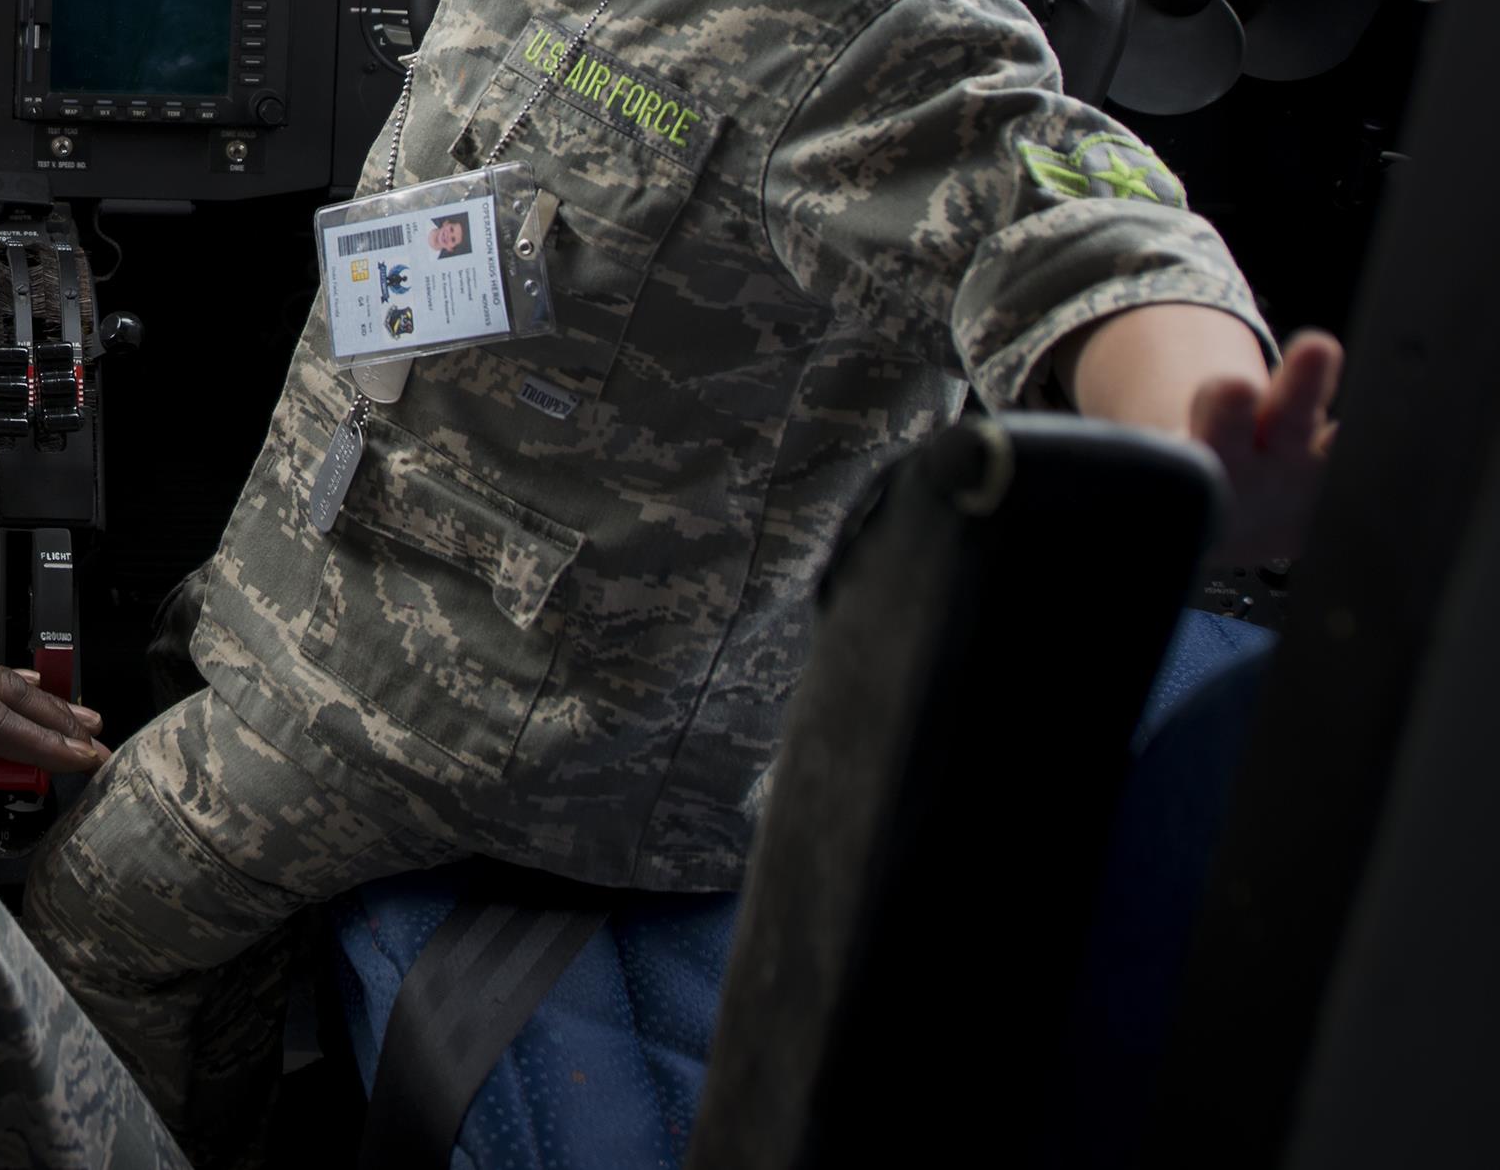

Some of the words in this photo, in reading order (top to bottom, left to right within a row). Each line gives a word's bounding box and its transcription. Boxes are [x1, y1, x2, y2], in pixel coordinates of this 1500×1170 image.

[564, 54, 610, 102] AIR
[606, 75, 701, 149] FORCE
[482, 202, 493, 255] OPERATION
[486, 256, 497, 279] KIDS
[489, 279, 501, 306] HERO
[522, 382, 571, 413] TROOPER
[40, 551, 72, 562] FLIGHT
[40, 631, 74, 642] GROUND
